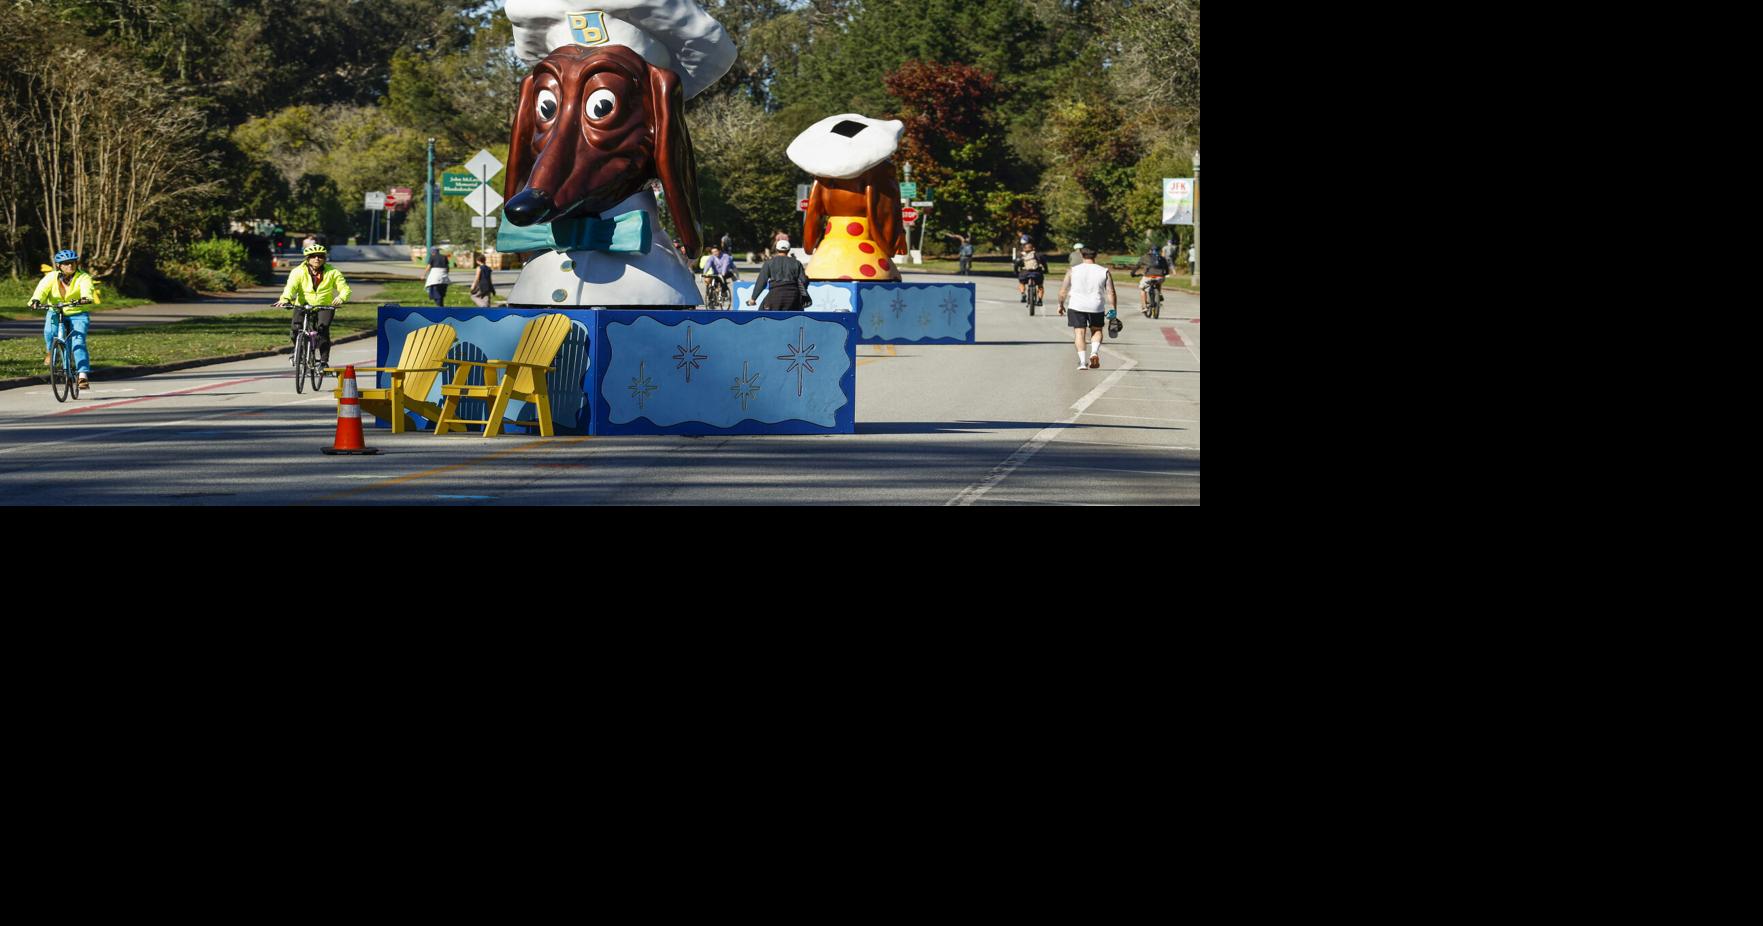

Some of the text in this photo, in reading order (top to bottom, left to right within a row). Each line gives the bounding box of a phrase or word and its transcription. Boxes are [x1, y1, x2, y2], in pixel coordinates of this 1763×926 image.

[571, 15, 588, 30] D
[583, 27, 602, 43] D
[1170, 182, 1186, 190] JFK
